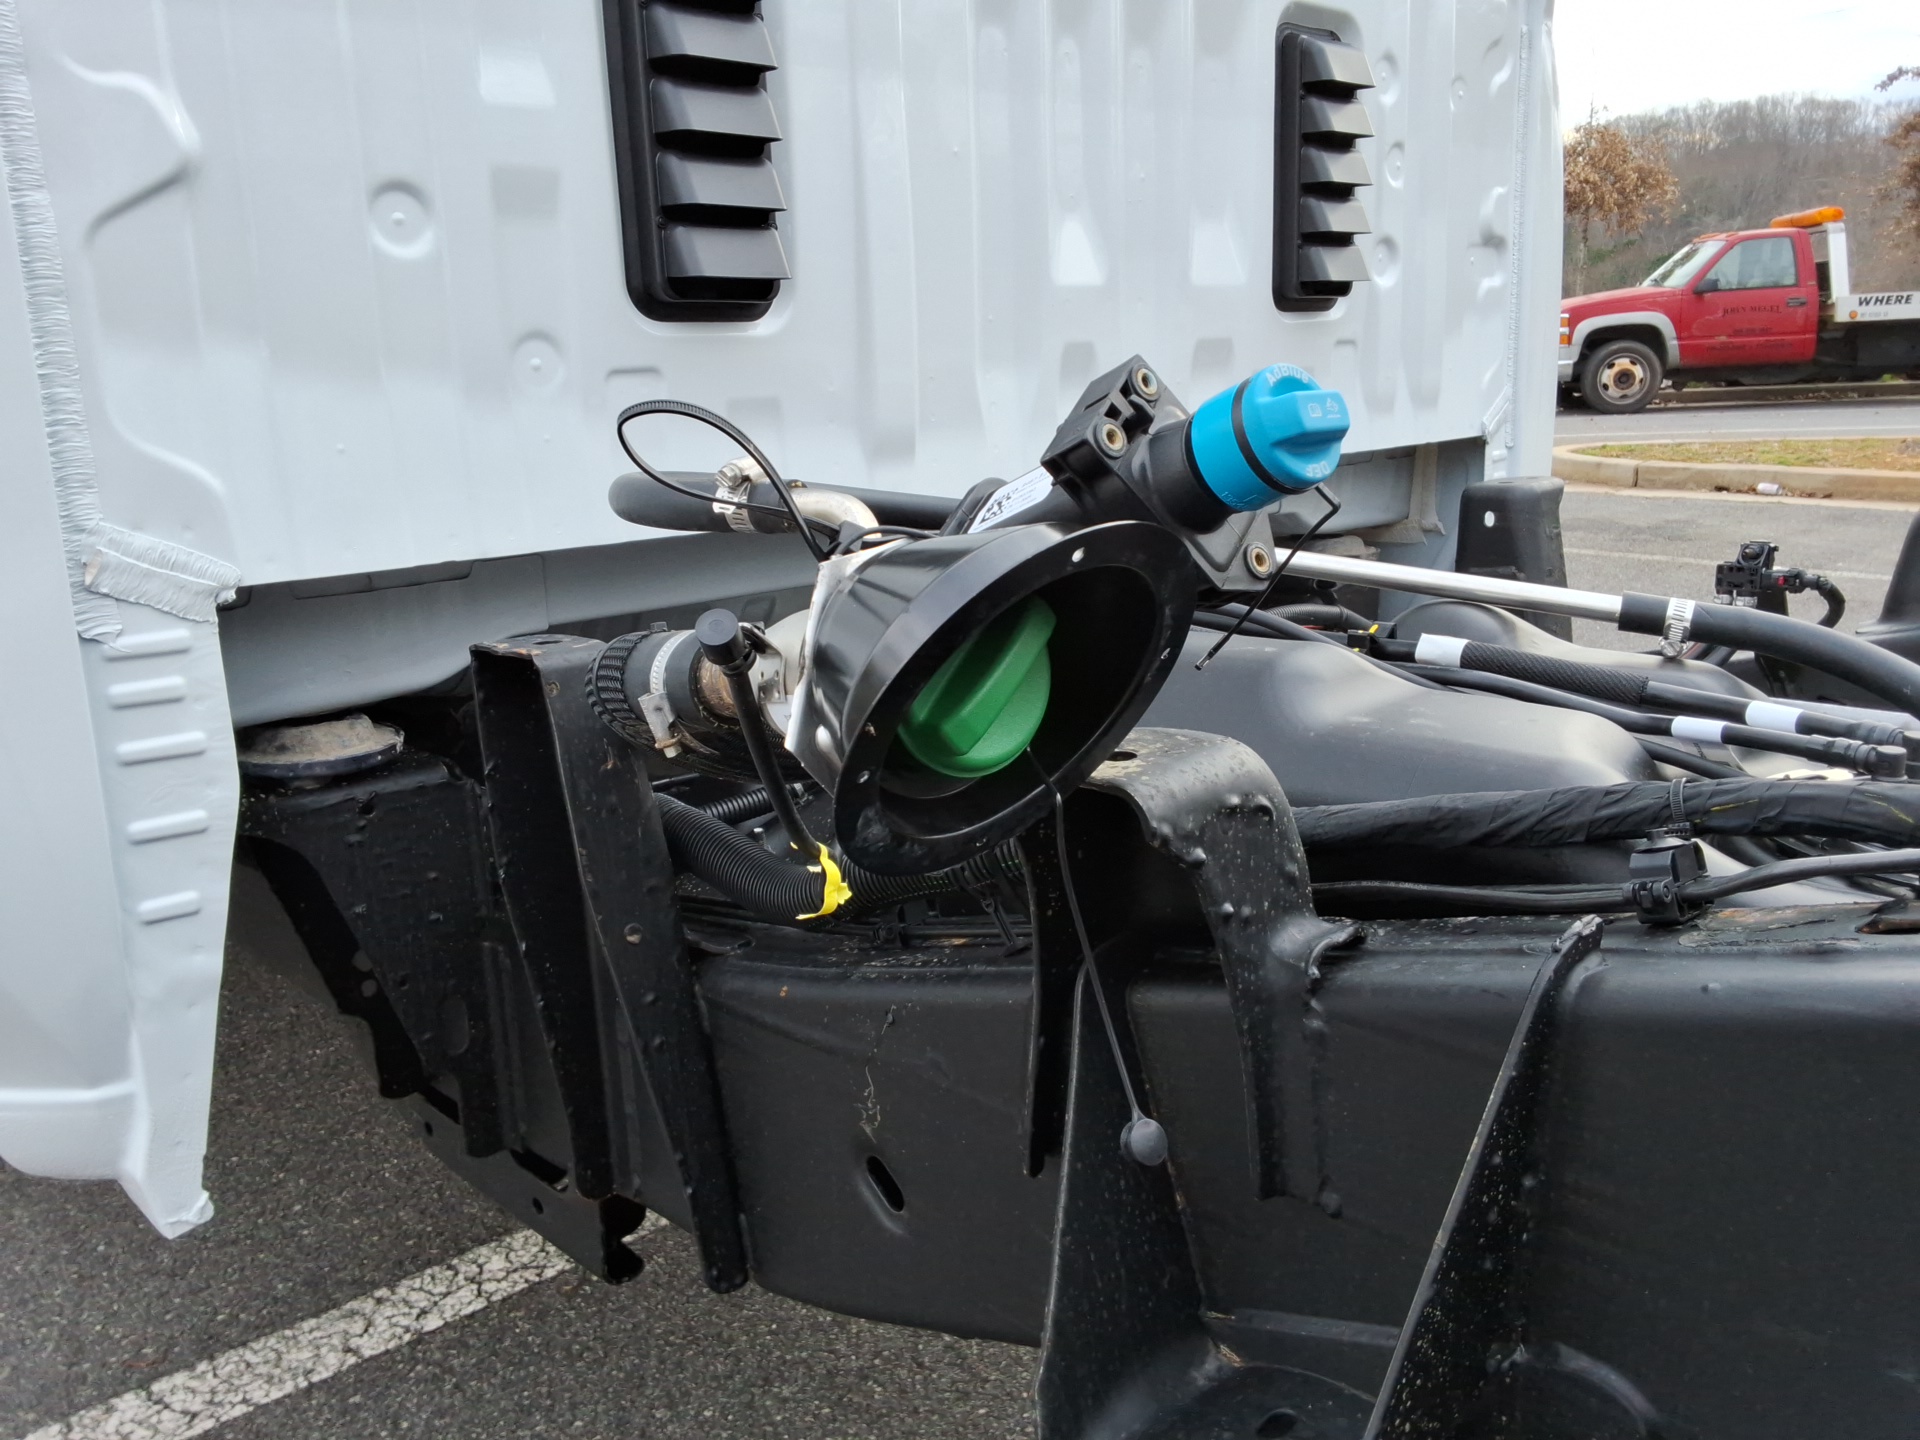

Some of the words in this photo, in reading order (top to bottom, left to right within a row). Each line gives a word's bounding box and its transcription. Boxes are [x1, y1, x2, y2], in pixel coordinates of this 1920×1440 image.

[1858, 294, 1914, 307] WHERE
[1265, 364, 1310, 387] AdBlue
[1305, 461, 1330, 477] DEF
